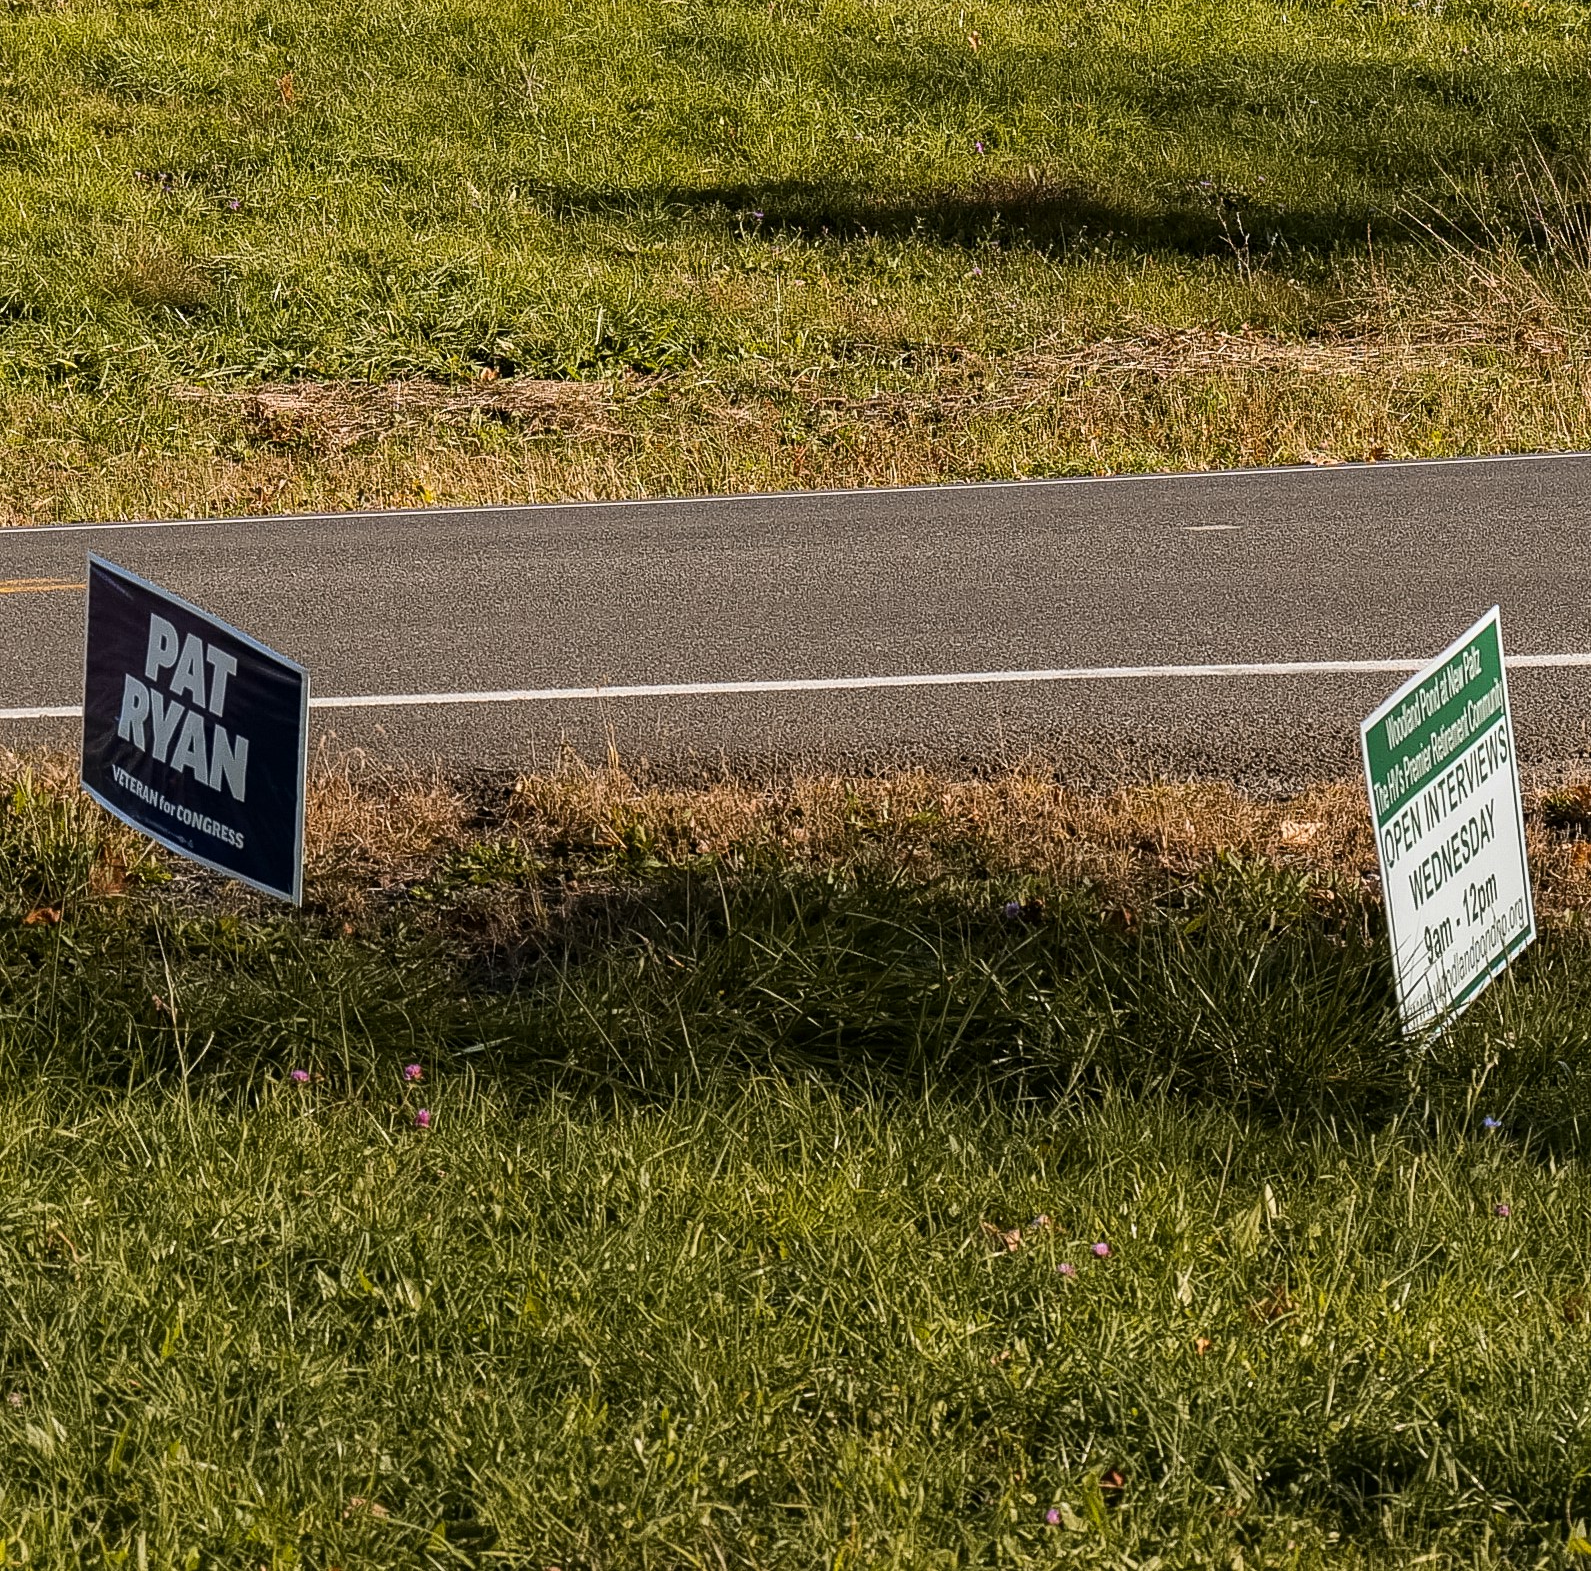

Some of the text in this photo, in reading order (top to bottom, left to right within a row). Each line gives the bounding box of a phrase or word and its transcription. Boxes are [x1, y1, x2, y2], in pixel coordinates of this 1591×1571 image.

[145, 612, 238, 718] PAT
[1385, 645, 1482, 750] Woodland Pond at New Paltz
[117, 673, 249, 803] RYAN
[1373, 781, 1390, 816] The
[1402, 742, 1432, 789] Premier
[1430, 707, 1469, 765] Retirement
[1467, 677, 1505, 732] Community
[112, 764, 159, 807] VETERAN
[159, 795, 176, 817] for
[176, 805, 245, 849] CONGRESS
[1384, 724, 1508, 868] OPEN INTERVIEWS
[1408, 798, 1495, 911] WEDNESDAY
[1424, 917, 1454, 966] 9am
[1463, 873, 1498, 927] 12pm
